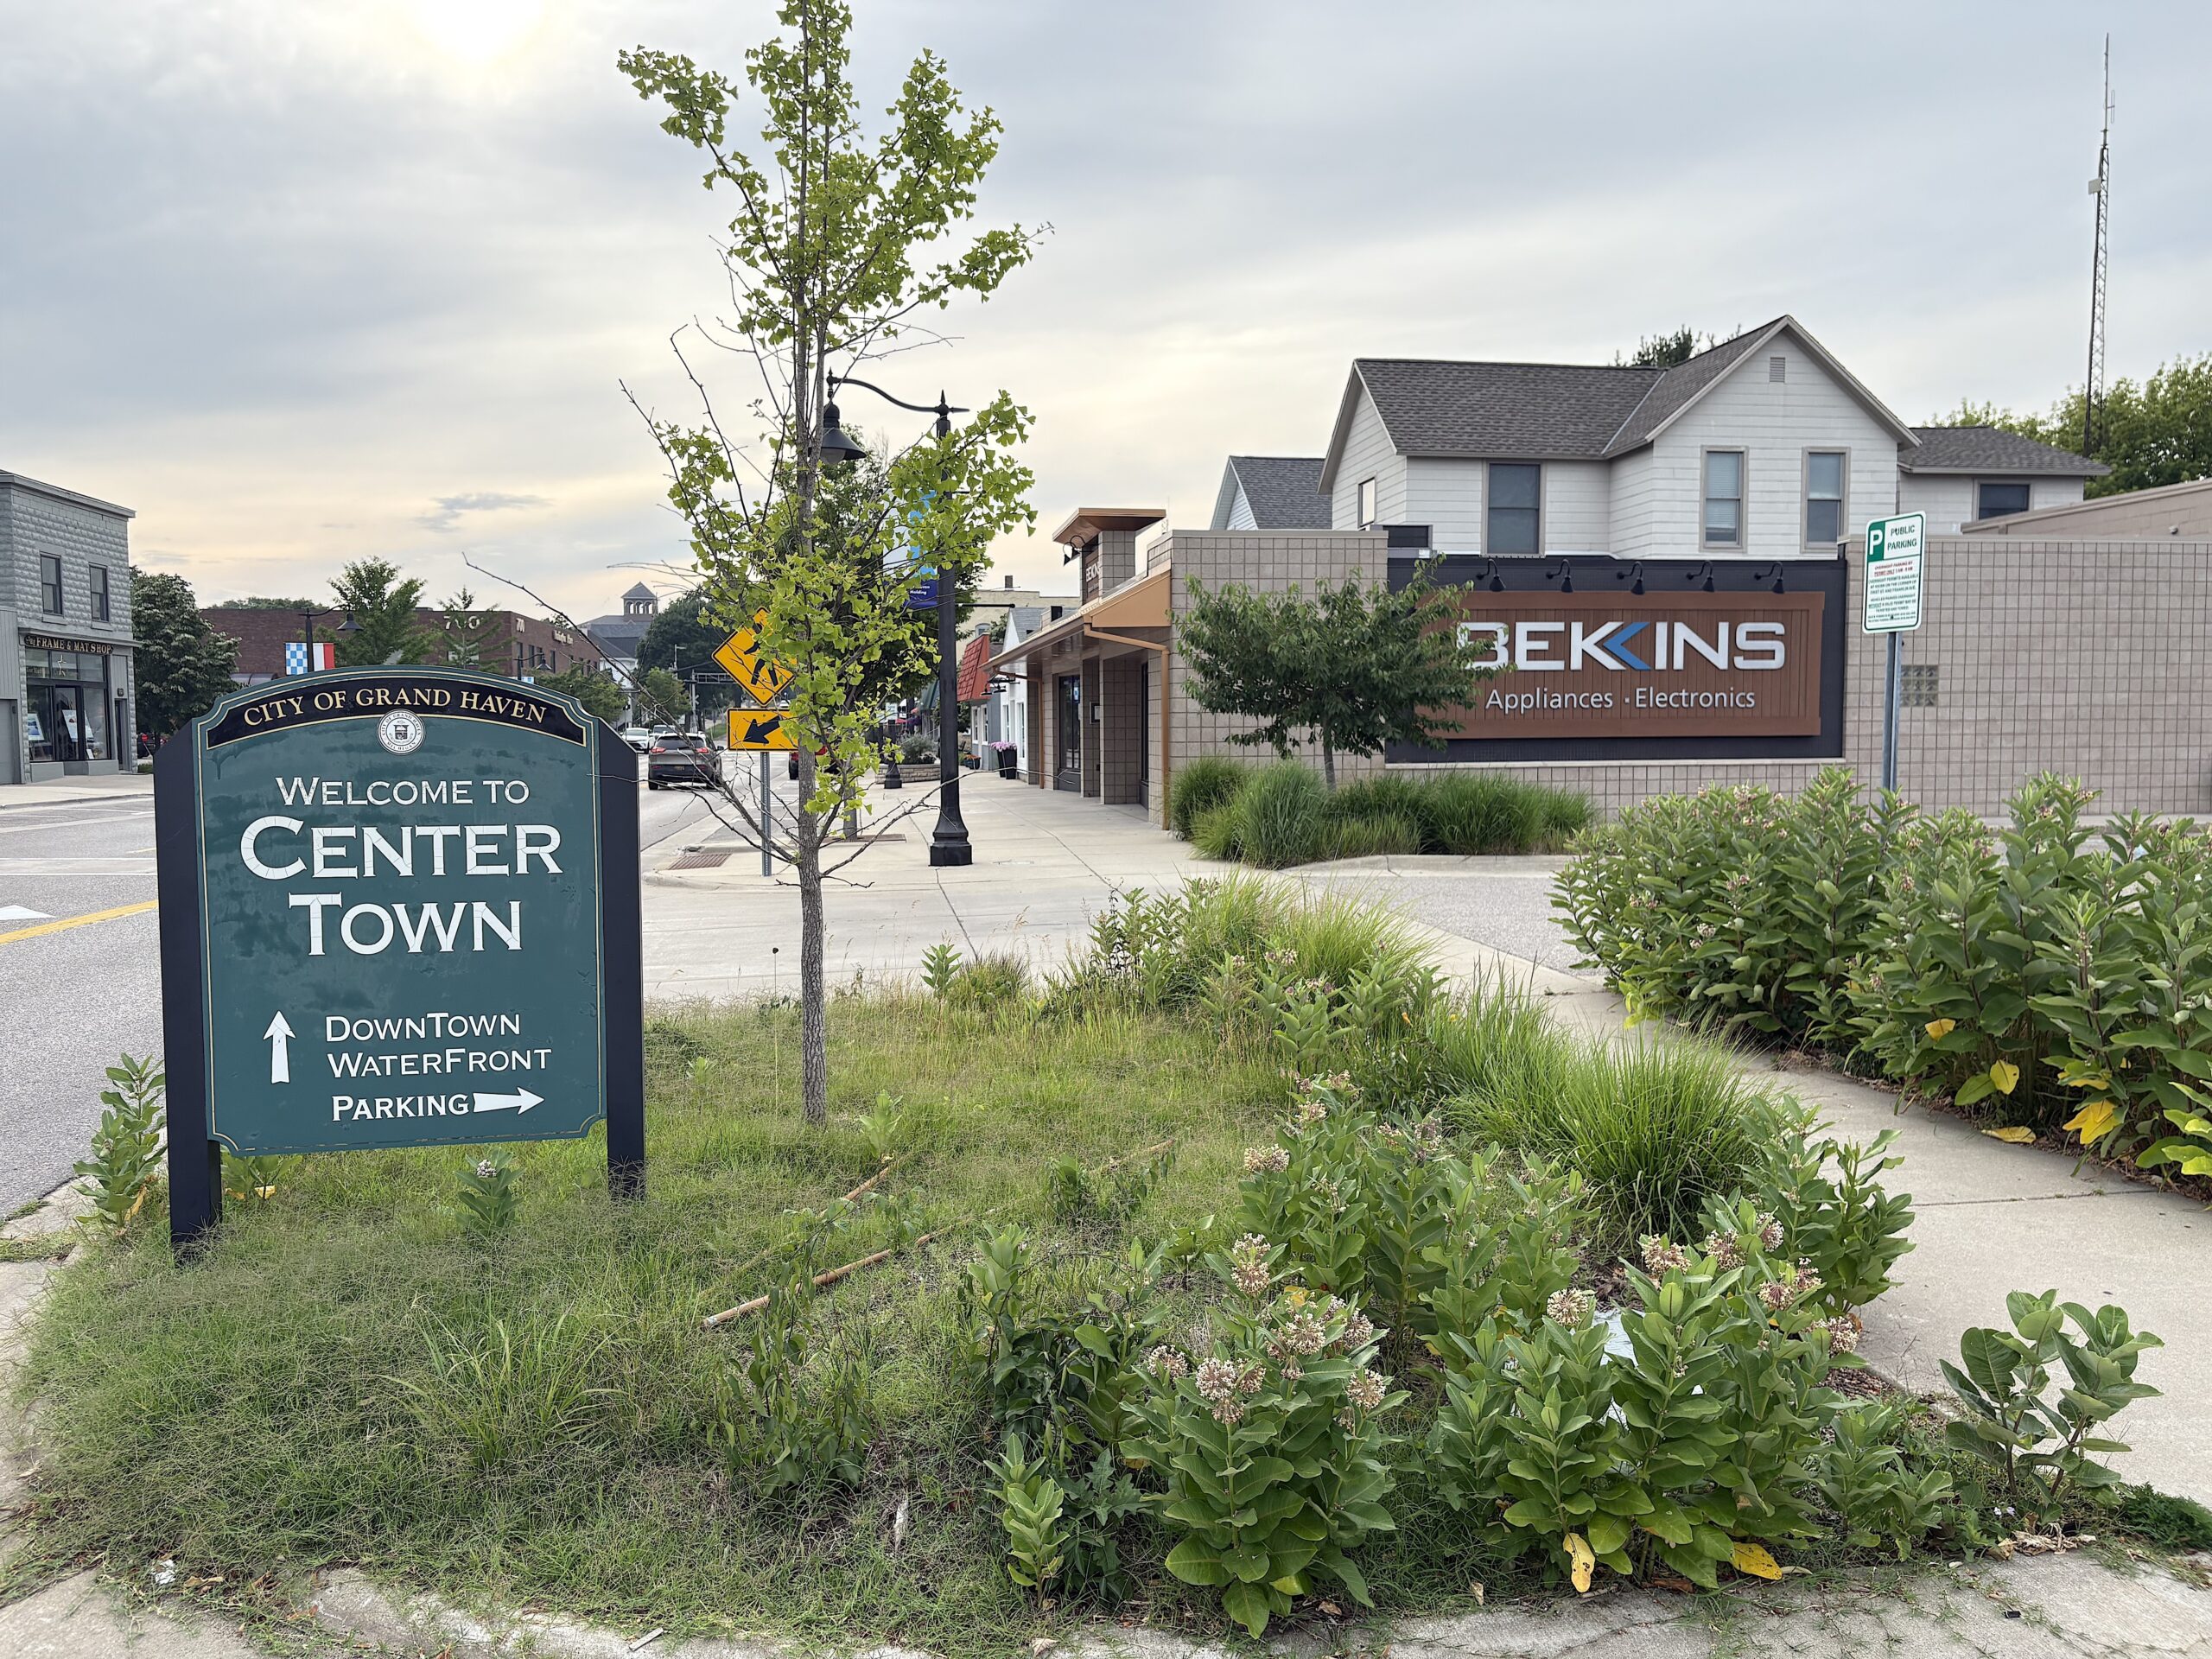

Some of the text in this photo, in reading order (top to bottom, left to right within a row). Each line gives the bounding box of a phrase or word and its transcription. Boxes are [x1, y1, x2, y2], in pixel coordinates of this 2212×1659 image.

[1870, 529, 1883, 555] P
[1888, 538, 1916, 550] PARKING
[1891, 525, 1915, 536] PUBLIC
[36, 637, 65, 650] FRAME
[66, 640, 72, 650] &
[73, 641, 89, 652] MAT
[90, 644, 111, 654] SHOP
[1456, 621, 1785, 671] BEKINS
[244, 688, 547, 727] CITY OF GRAND HAVEN
[1485, 687, 1756, 715] Appliances Electronics
[275, 777, 531, 806] WELCOME TO
[239, 815, 563, 880] CENTER
[288, 892, 523, 956] TOWN
[332, 1093, 470, 1122] PARKING
